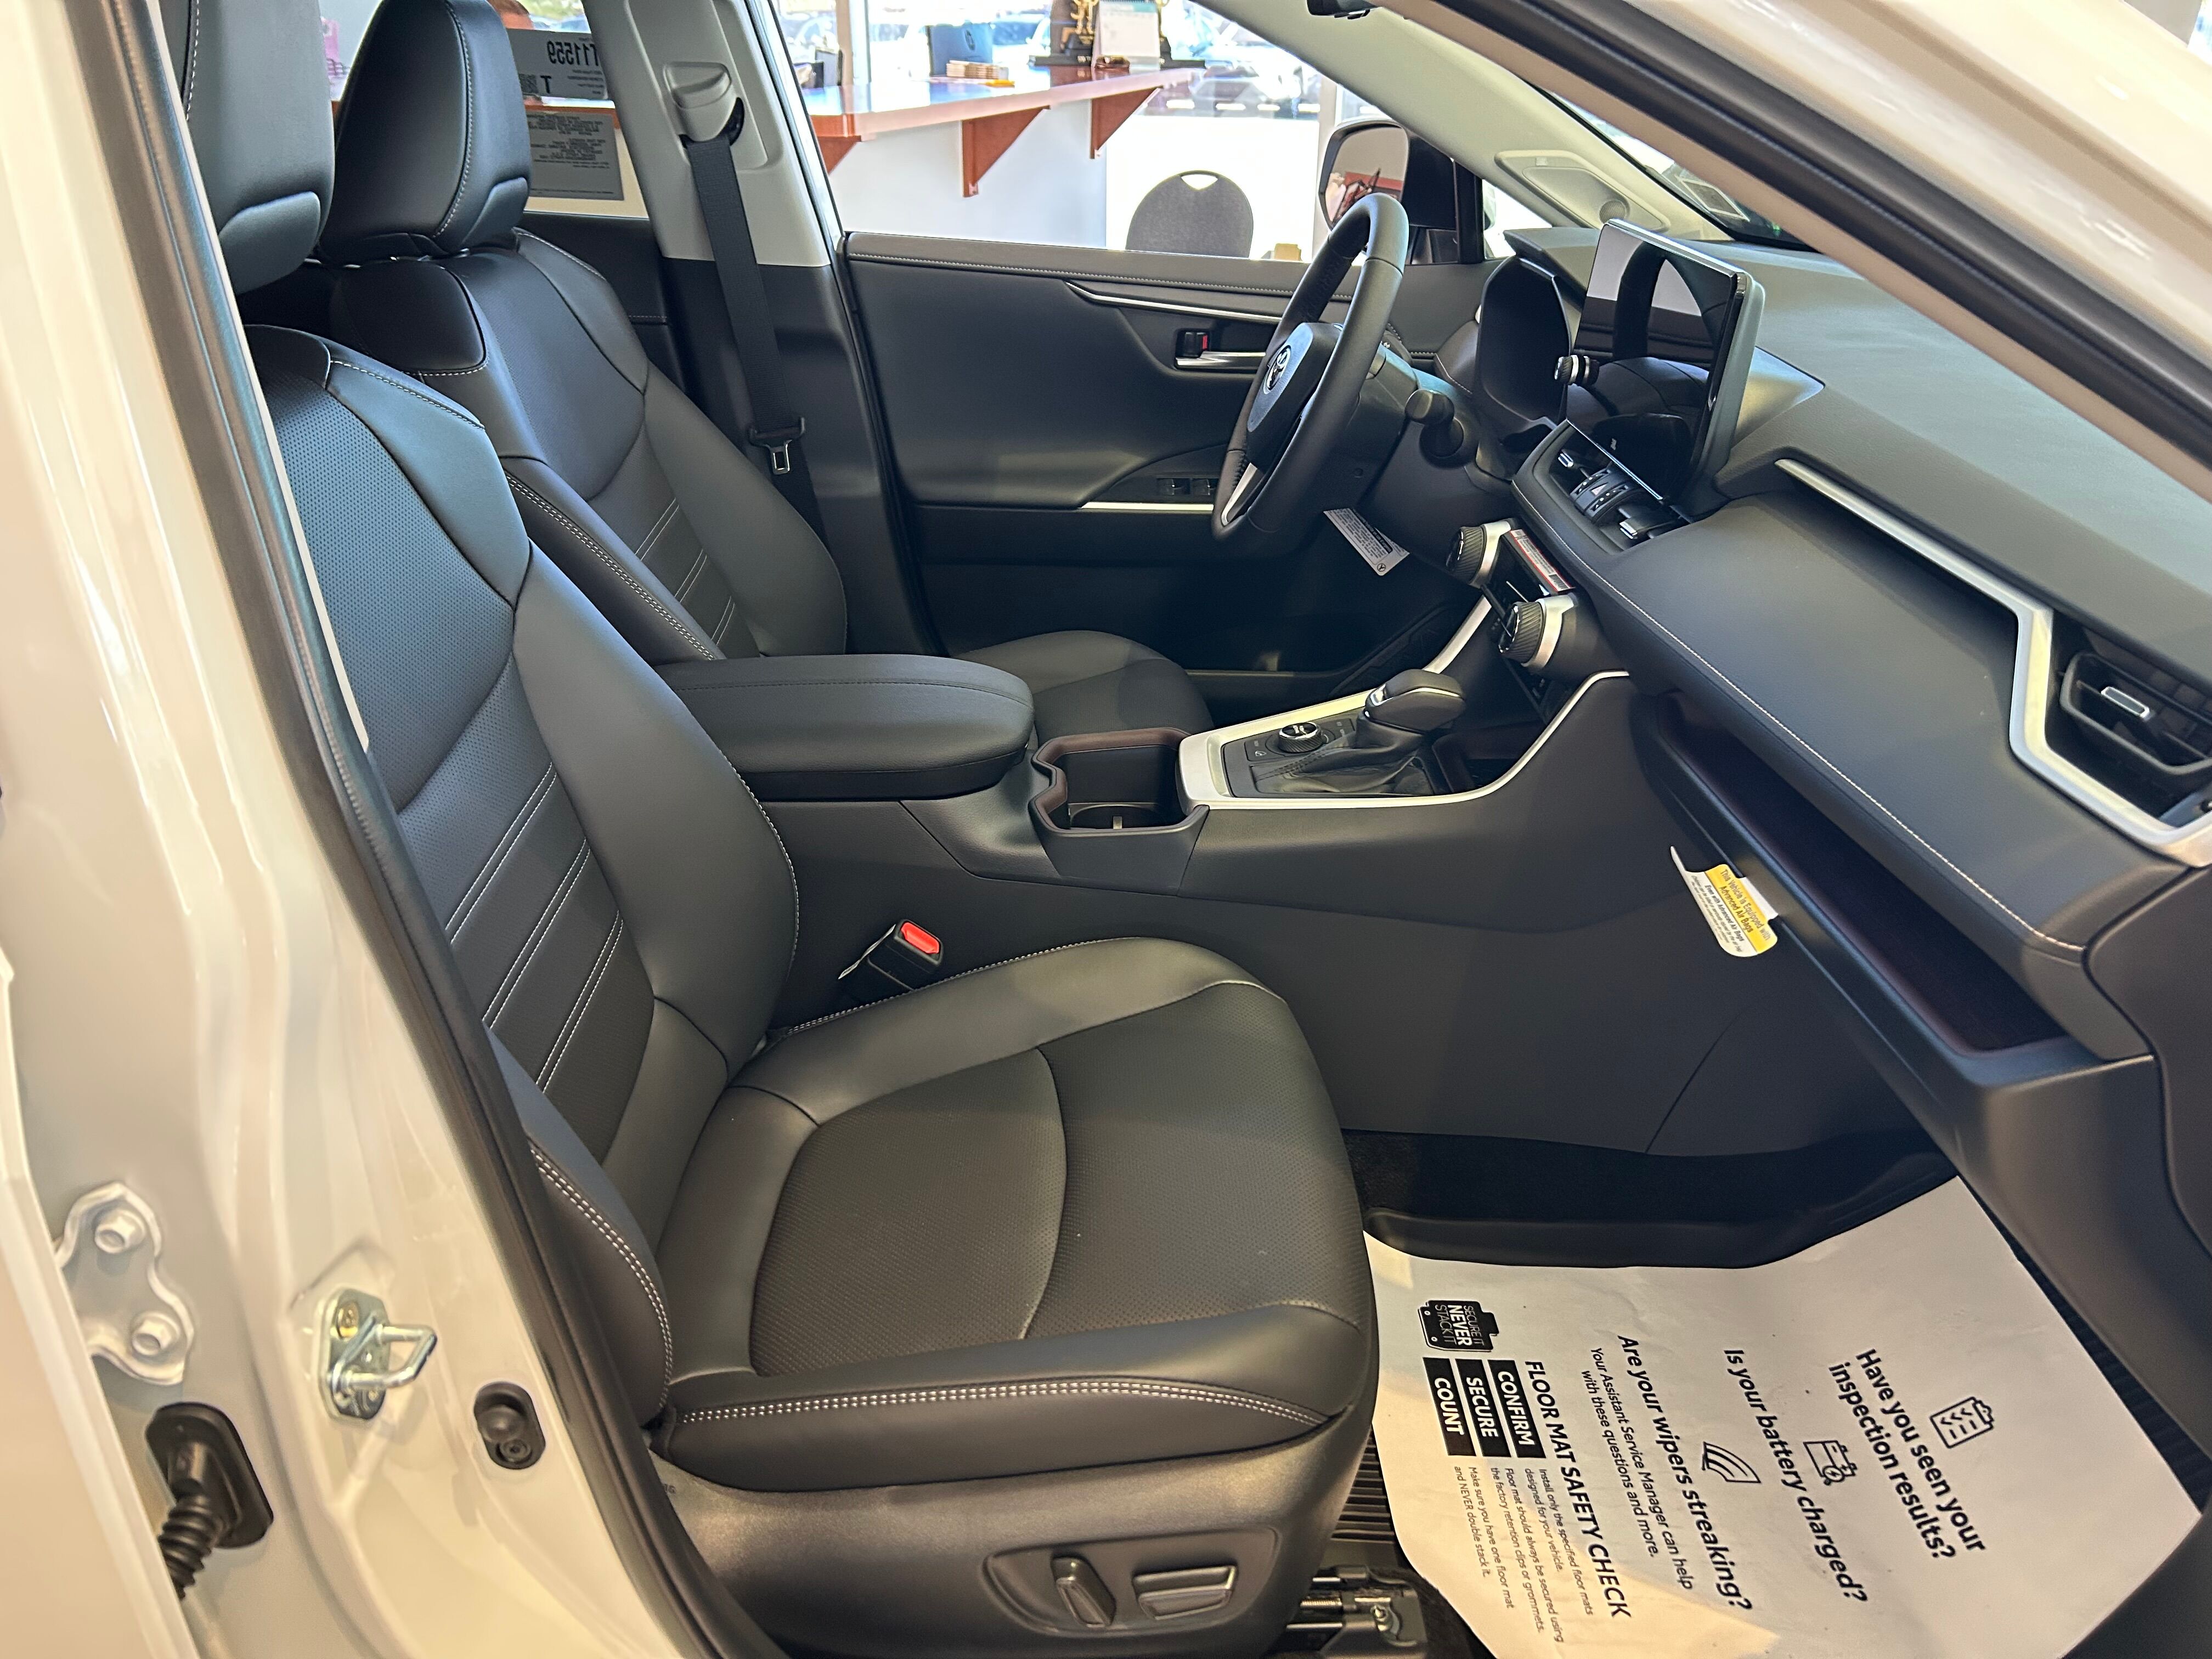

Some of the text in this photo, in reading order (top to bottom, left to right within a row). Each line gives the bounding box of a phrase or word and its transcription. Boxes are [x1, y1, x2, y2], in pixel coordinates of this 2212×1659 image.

[1705, 885, 1714, 894] Even
[1717, 905, 1734, 923] Advanced
[1735, 931, 1744, 941] Bags
[1719, 886, 1740, 910] Advanced
[1741, 918, 1753, 933] Bags
[1720, 869, 1730, 881] This
[1729, 881, 1743, 899] Vehicle
[1743, 903, 1764, 928] Equipped
[1759, 928, 1771, 940] with
[1435, 1305, 1453, 1334] STACK
[1448, 1305, 1472, 1345] NEVER
[1464, 1306, 1481, 1336] SECURE
[1435, 1378, 1464, 1435] COUNT
[1466, 1378, 1498, 1437] SECURE
[1498, 1372, 1534, 1444] CONFIRM
[1581, 1371, 1658, 1558] with these questions and more.
[1591, 1348, 1694, 1590] Your Assistant Service Manager can help
[1829, 1362, 1956, 1558] inspection results?
[1855, 1348, 1986, 1550] Have you seen your
[1454, 1466, 1491, 1577] and NEVER double stack it.
[1525, 1361, 1632, 1618] FLOOR MAT SAFETY CHECK
[1525, 1469, 1564, 1572] designed for your vehicle.
[1617, 1335, 1753, 1610] Are your wipers streaking?
[1724, 1350, 1867, 1601] Is your battery charged?
[1469, 1467, 1515, 1609] Make sure you have one floor mat
[1491, 1468, 1544, 1633] the factory retention clips or grommets.
[1505, 1468, 1564, 1643] Floor mat should always be secured using
[1539, 1469, 1593, 1615] Install only the specified floor mats
